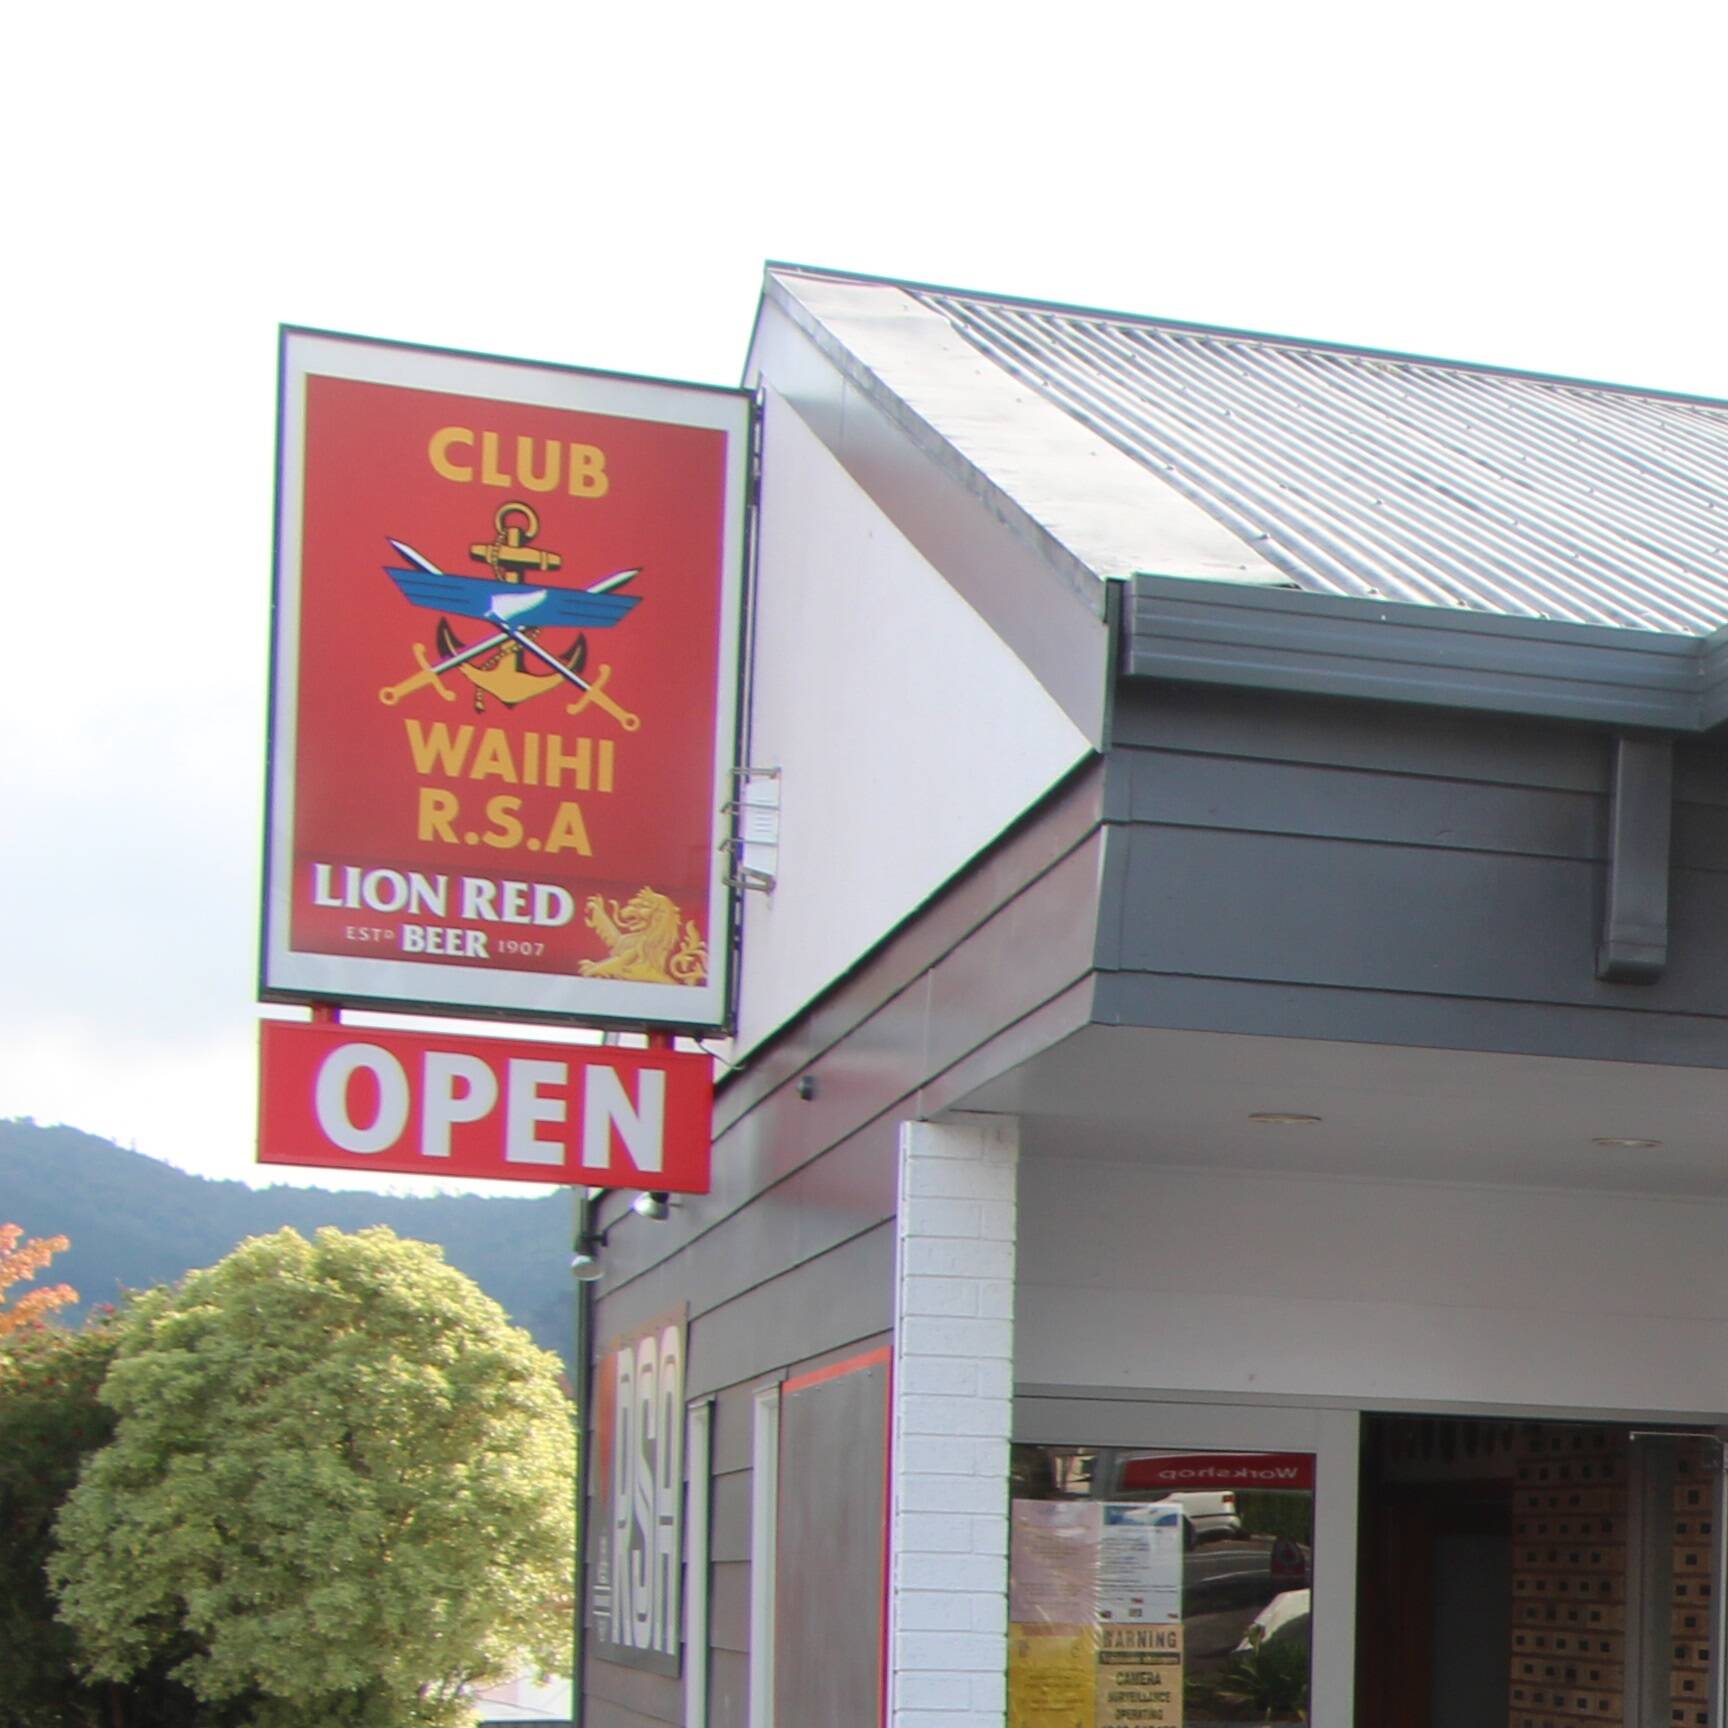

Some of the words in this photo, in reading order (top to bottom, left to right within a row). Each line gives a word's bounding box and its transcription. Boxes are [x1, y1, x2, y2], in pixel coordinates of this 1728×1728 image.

[428, 426, 609, 498] CLUB
[405, 718, 615, 792] WAIHI
[417, 787, 593, 856] R.S.A
[313, 863, 448, 917] LION
[461, 877, 576, 927] RED
[402, 924, 490, 959] BEER
[498, 940, 545, 956] 1907
[315, 1042, 668, 1174] OPEN
[611, 1324, 682, 1656] RSA
